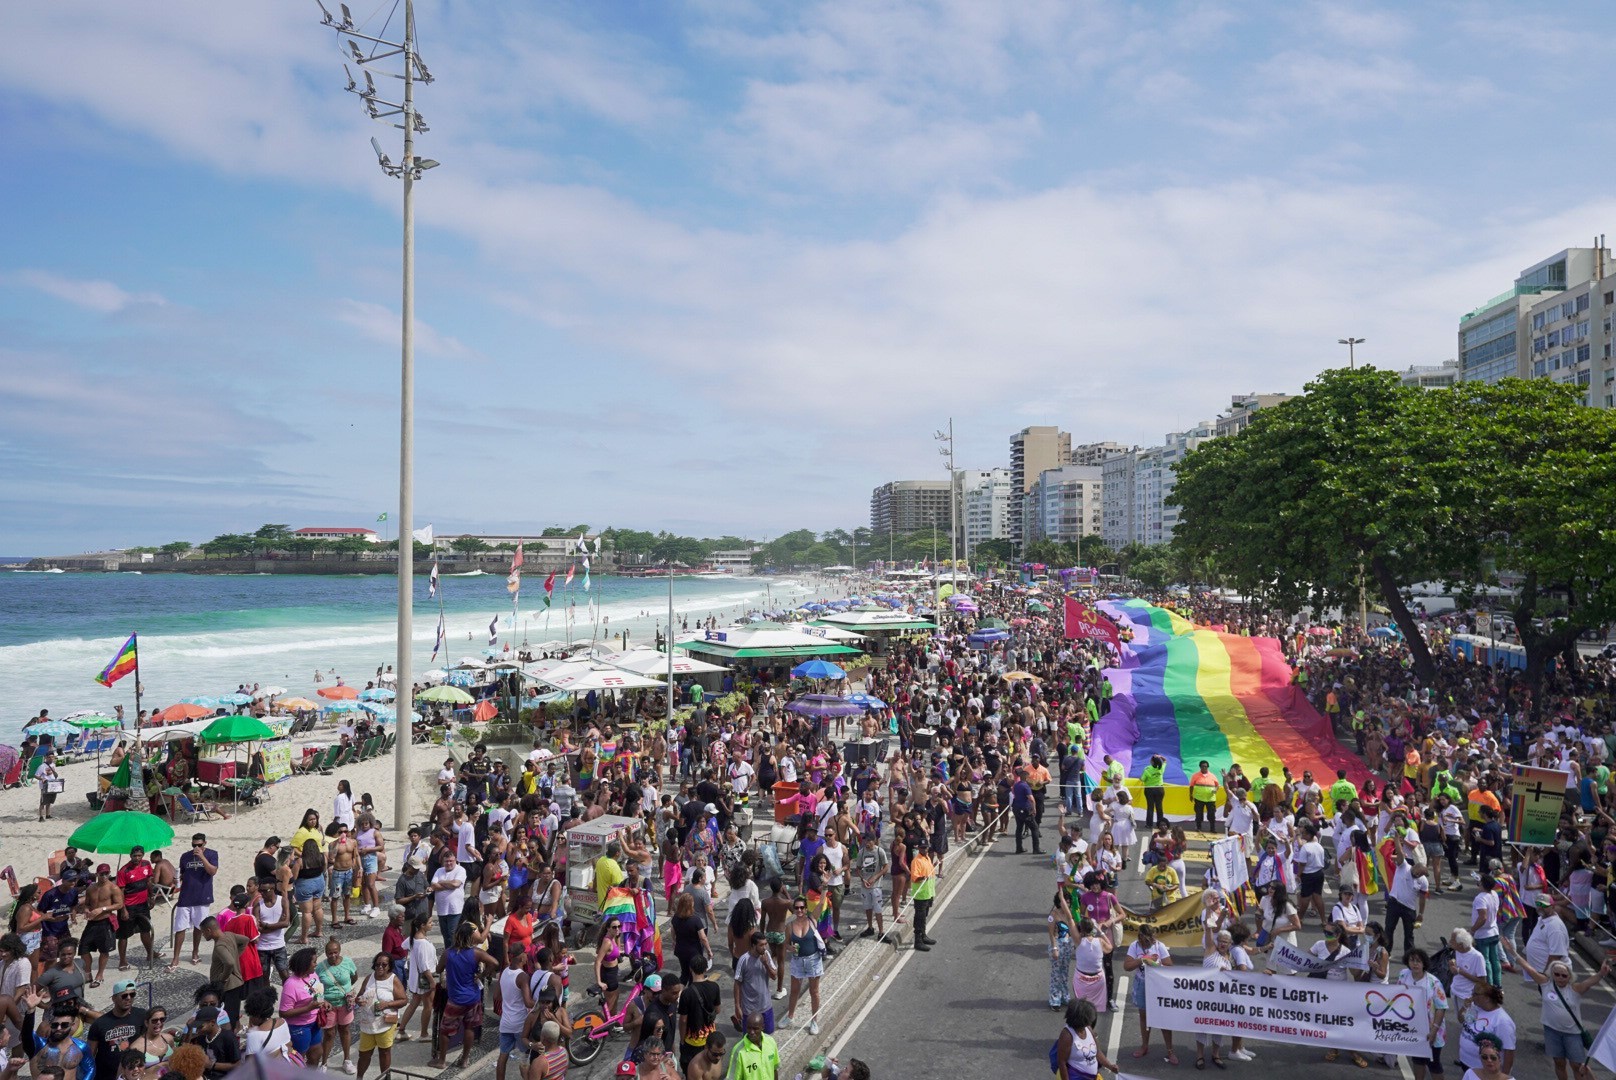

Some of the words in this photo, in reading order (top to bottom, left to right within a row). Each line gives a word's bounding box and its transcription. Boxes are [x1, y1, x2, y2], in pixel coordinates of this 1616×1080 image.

[571, 833, 585, 841] HOT
[1278, 946, 1302, 965] Mães
[1173, 977, 1215, 992] SOMOS
[1219, 979, 1256, 997] MÃES
[1260, 986, 1278, 999] DE
[1282, 988, 1329, 1003] LGBTI+
[1157, 996, 1193, 1010] TEMOS
[1196, 1000, 1245, 1015] ORGULHO
[1249, 1006, 1264, 1018] DE
[1268, 1008, 1311, 1023] NOSSOS
[1314, 1013, 1355, 1027] FILHES
[1194, 1016, 1235, 1028] QUEREMOS
[1237, 1021, 1268, 1032] NOSSOS
[1270, 1025, 1298, 1036] FILHES
[1300, 1028, 1327, 1039] VIVOS!
[1372, 1018, 1410, 1033] Mães
[746, 1062, 758, 1073] 76
